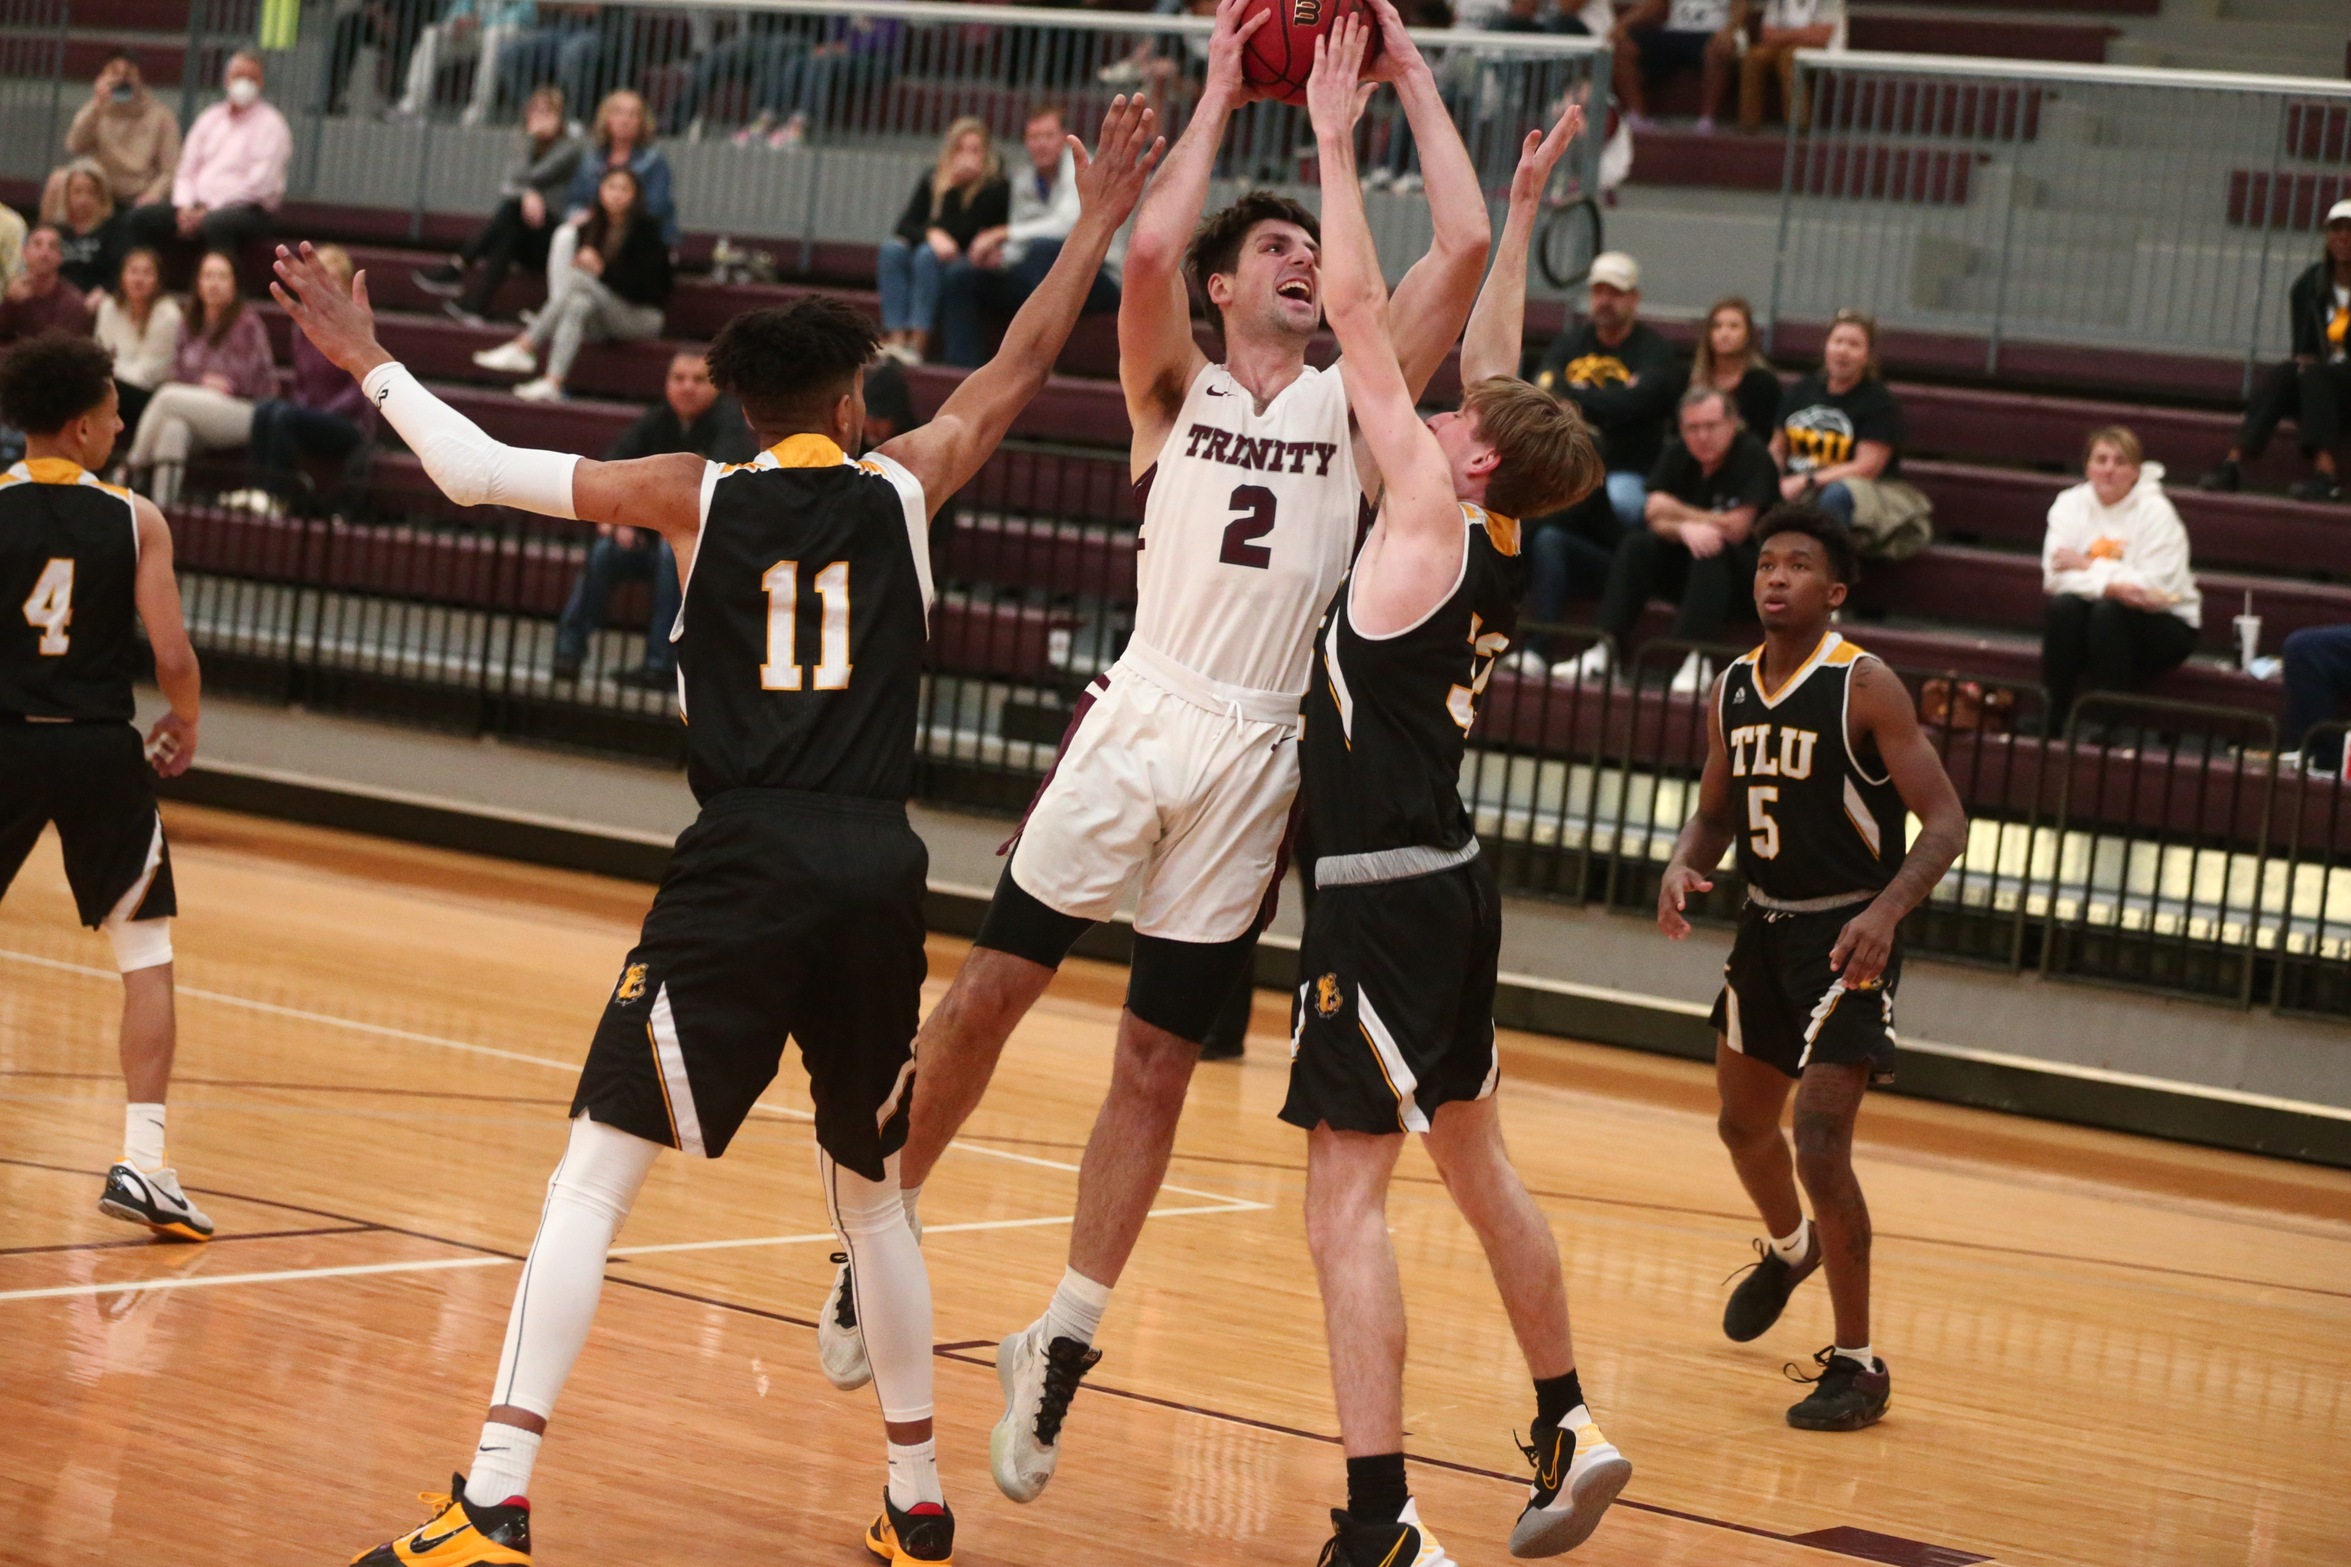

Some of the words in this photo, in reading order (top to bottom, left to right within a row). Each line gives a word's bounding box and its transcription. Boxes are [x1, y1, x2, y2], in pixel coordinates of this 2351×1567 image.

[1185, 423, 1337, 477] TRINITY
[1219, 483, 1277, 570] 2
[22, 557, 75, 656] 4
[759, 560, 854, 691] 11
[1731, 724, 1818, 780] TLU
[1748, 786, 1780, 860] 5
